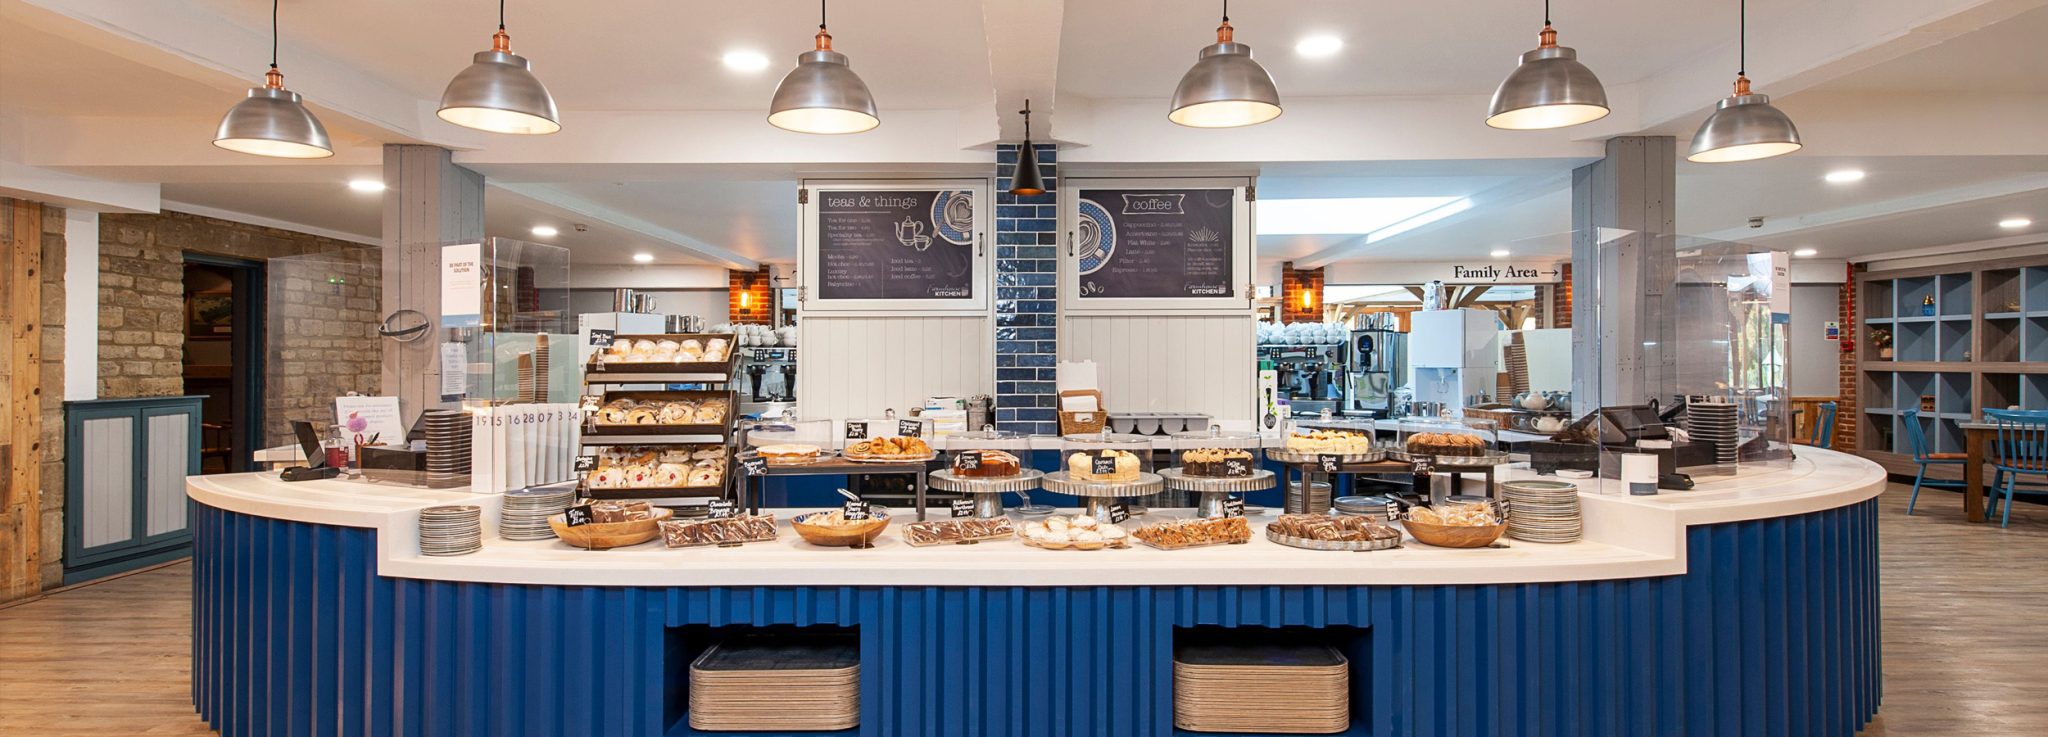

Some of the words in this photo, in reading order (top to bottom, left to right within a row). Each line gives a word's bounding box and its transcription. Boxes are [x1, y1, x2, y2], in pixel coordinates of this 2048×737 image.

[828, 196, 855, 207] teas
[859, 195, 871, 207] &
[874, 195, 917, 209] things
[1132, 198, 1172, 210] coffee
[1454, 265, 1501, 282] Family
[1505, 265, 1538, 278] Area
[477, 416, 487, 426] 19
[509, 415, 520, 425] 16
[523, 413, 535, 423] 28
